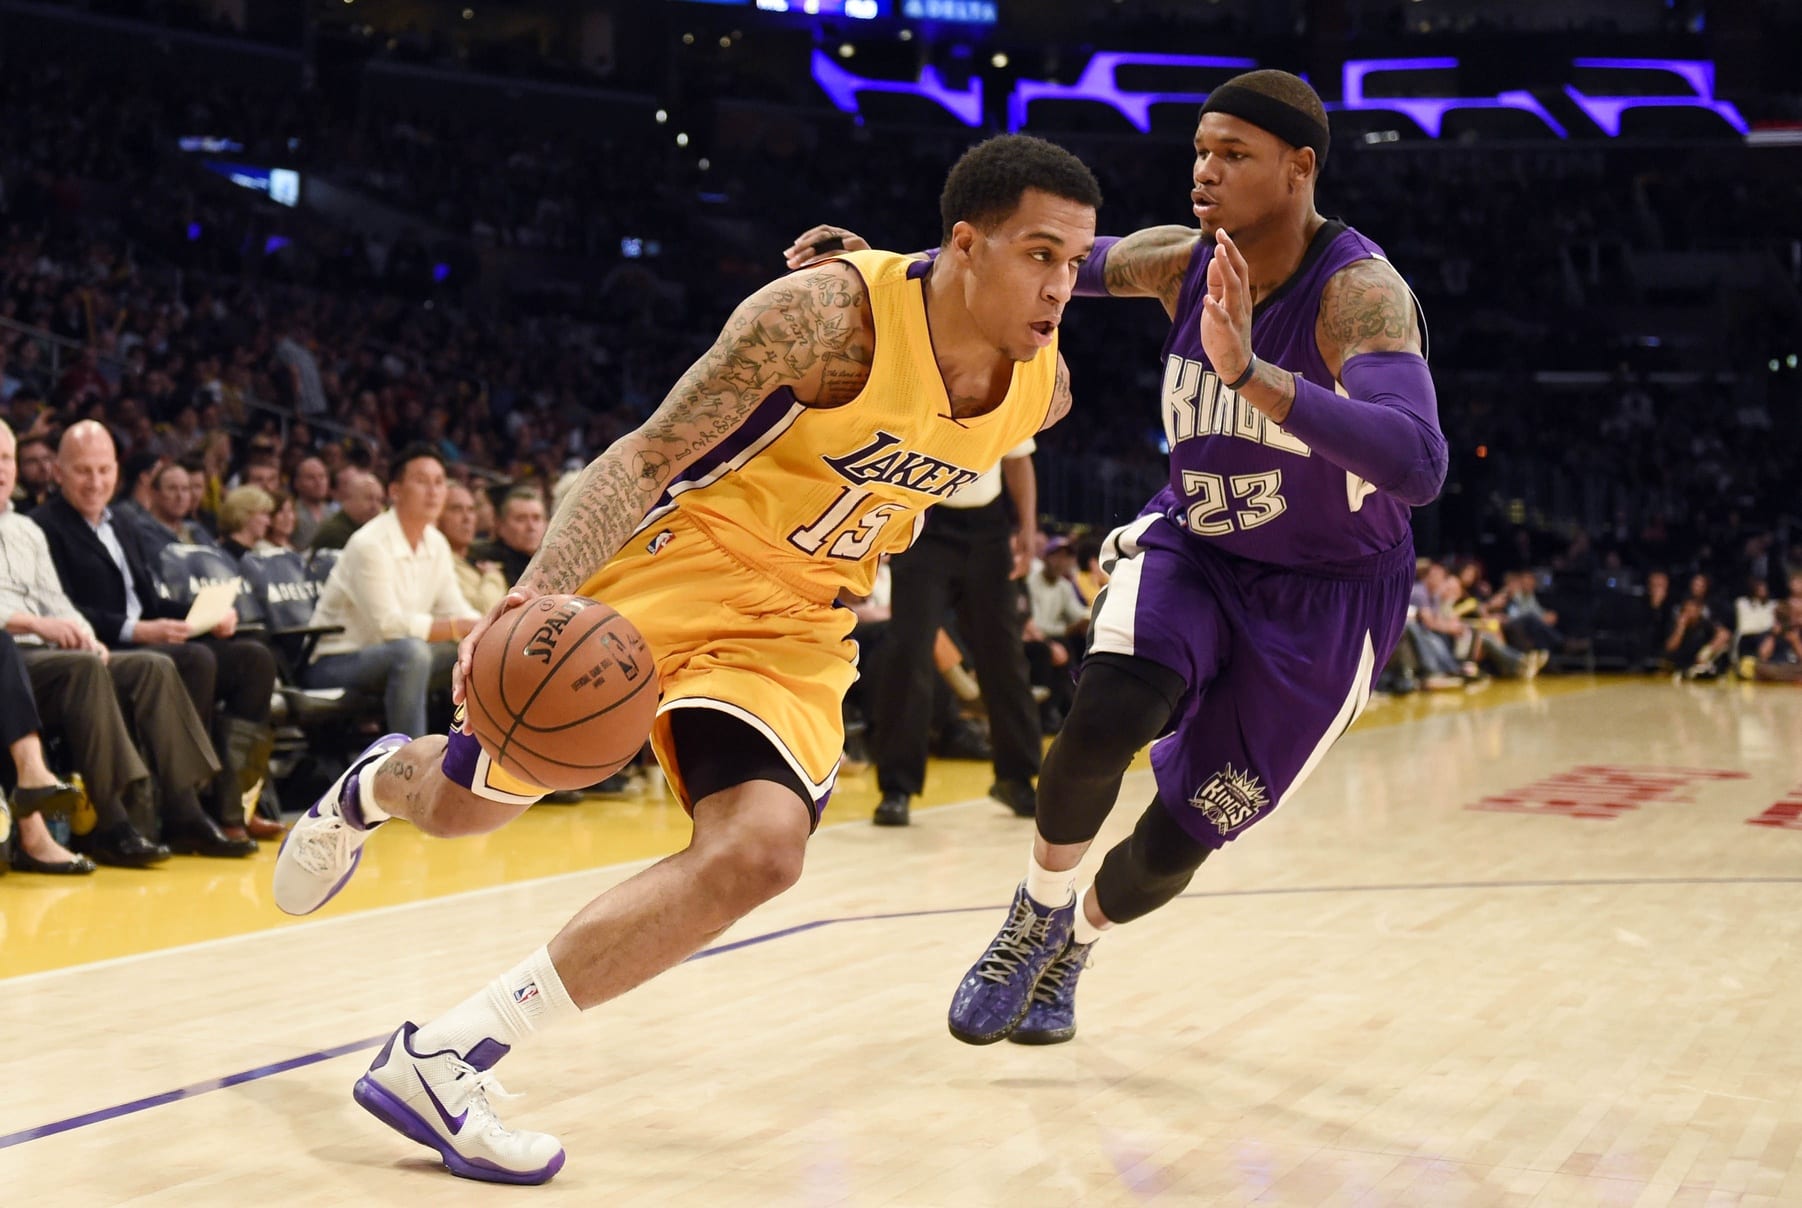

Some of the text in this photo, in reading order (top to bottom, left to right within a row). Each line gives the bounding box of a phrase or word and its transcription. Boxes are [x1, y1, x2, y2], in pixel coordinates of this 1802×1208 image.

[820, 429, 980, 498] LAKER
[1182, 469, 1287, 536] 23
[1200, 778, 1253, 827] KINGS
